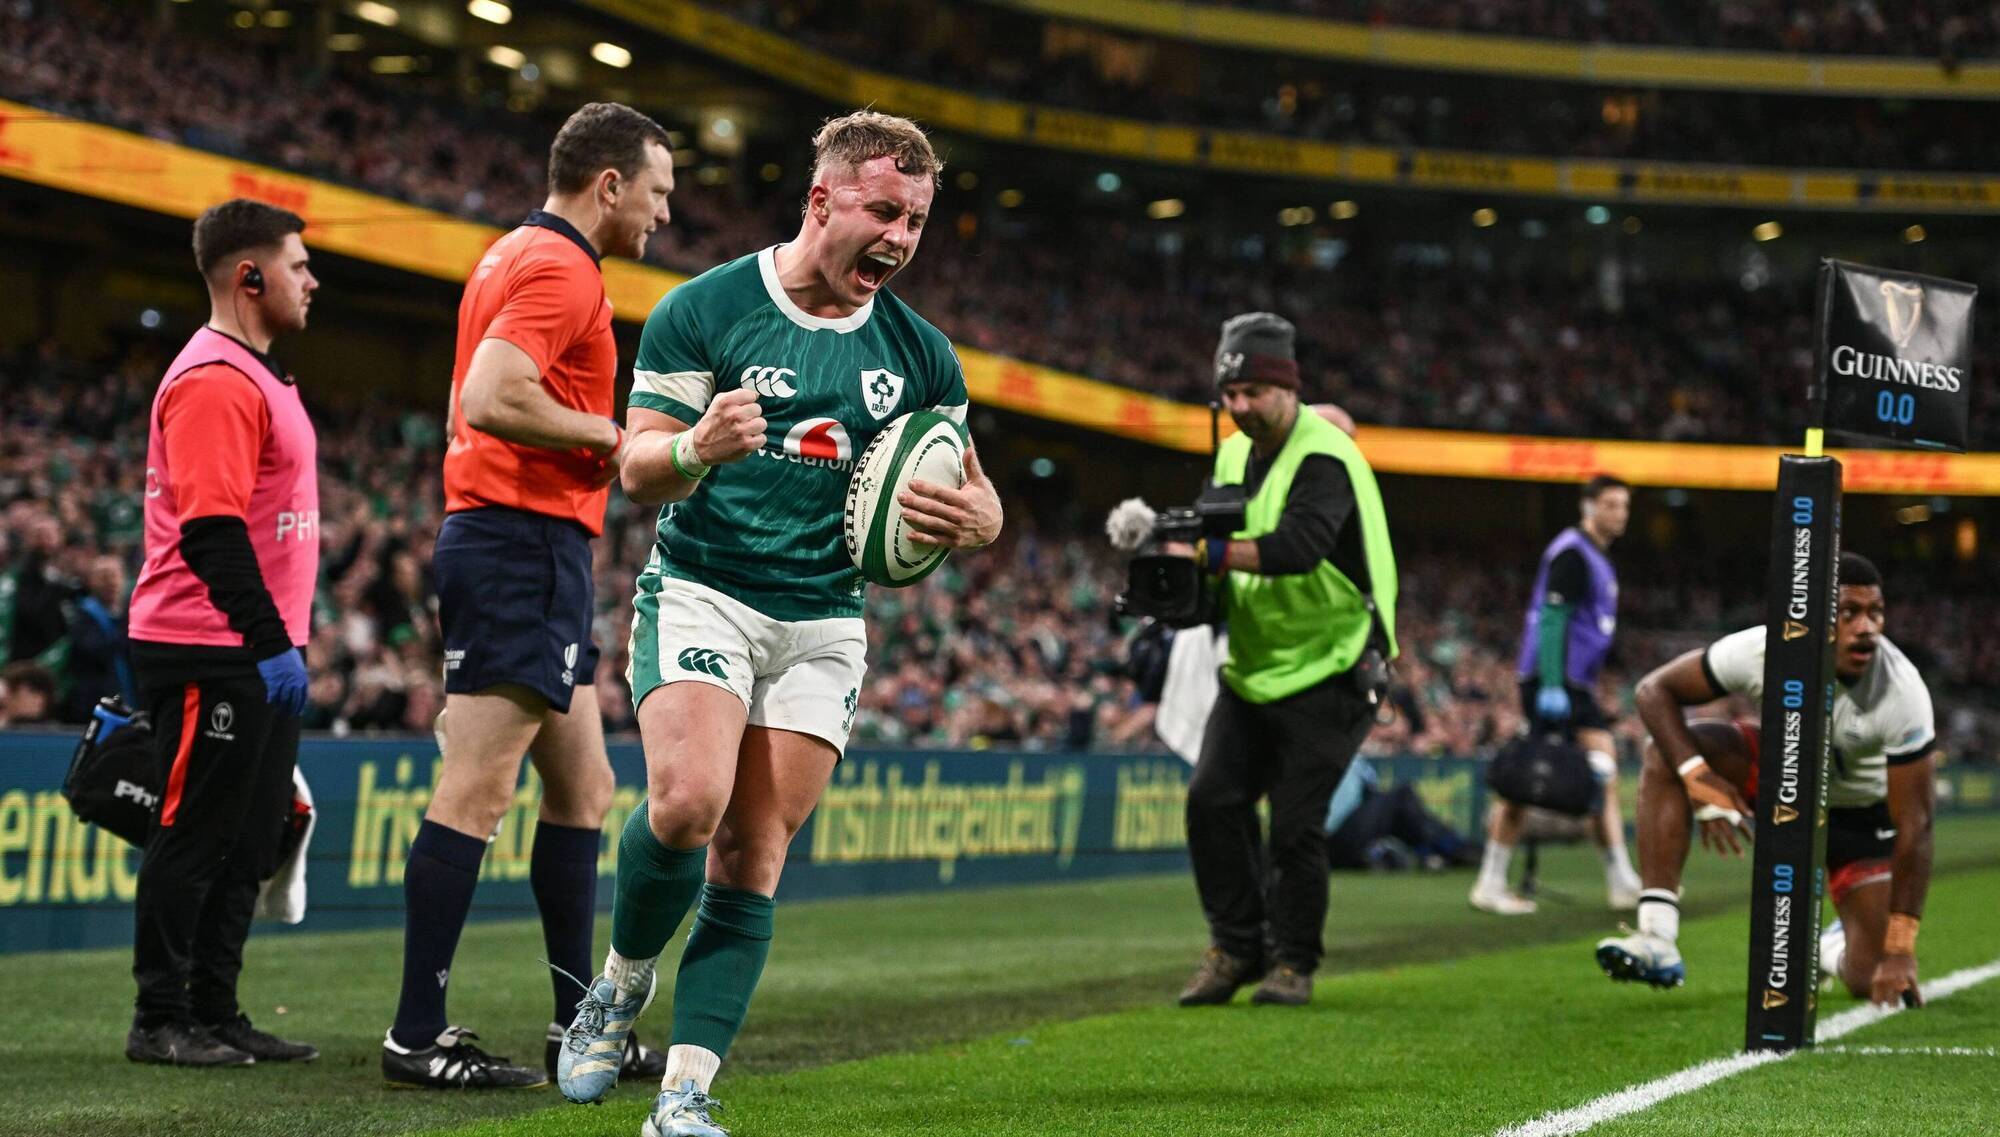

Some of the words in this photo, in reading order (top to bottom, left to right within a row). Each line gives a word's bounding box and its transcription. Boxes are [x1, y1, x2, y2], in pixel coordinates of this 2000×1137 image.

[1832, 345, 1961, 393] GUINNESS
[871, 402, 889, 414] IRFU
[1876, 389, 1915, 426] 0.0
[1792, 496, 1814, 525] 0.0
[1788, 528, 1812, 620] GUINNESS
[1783, 679, 1804, 709] 0.0
[1779, 711, 1802, 804] GUINNESS
[1773, 864, 1795, 893] 0.0
[1768, 896, 1792, 989] GUINNESS
